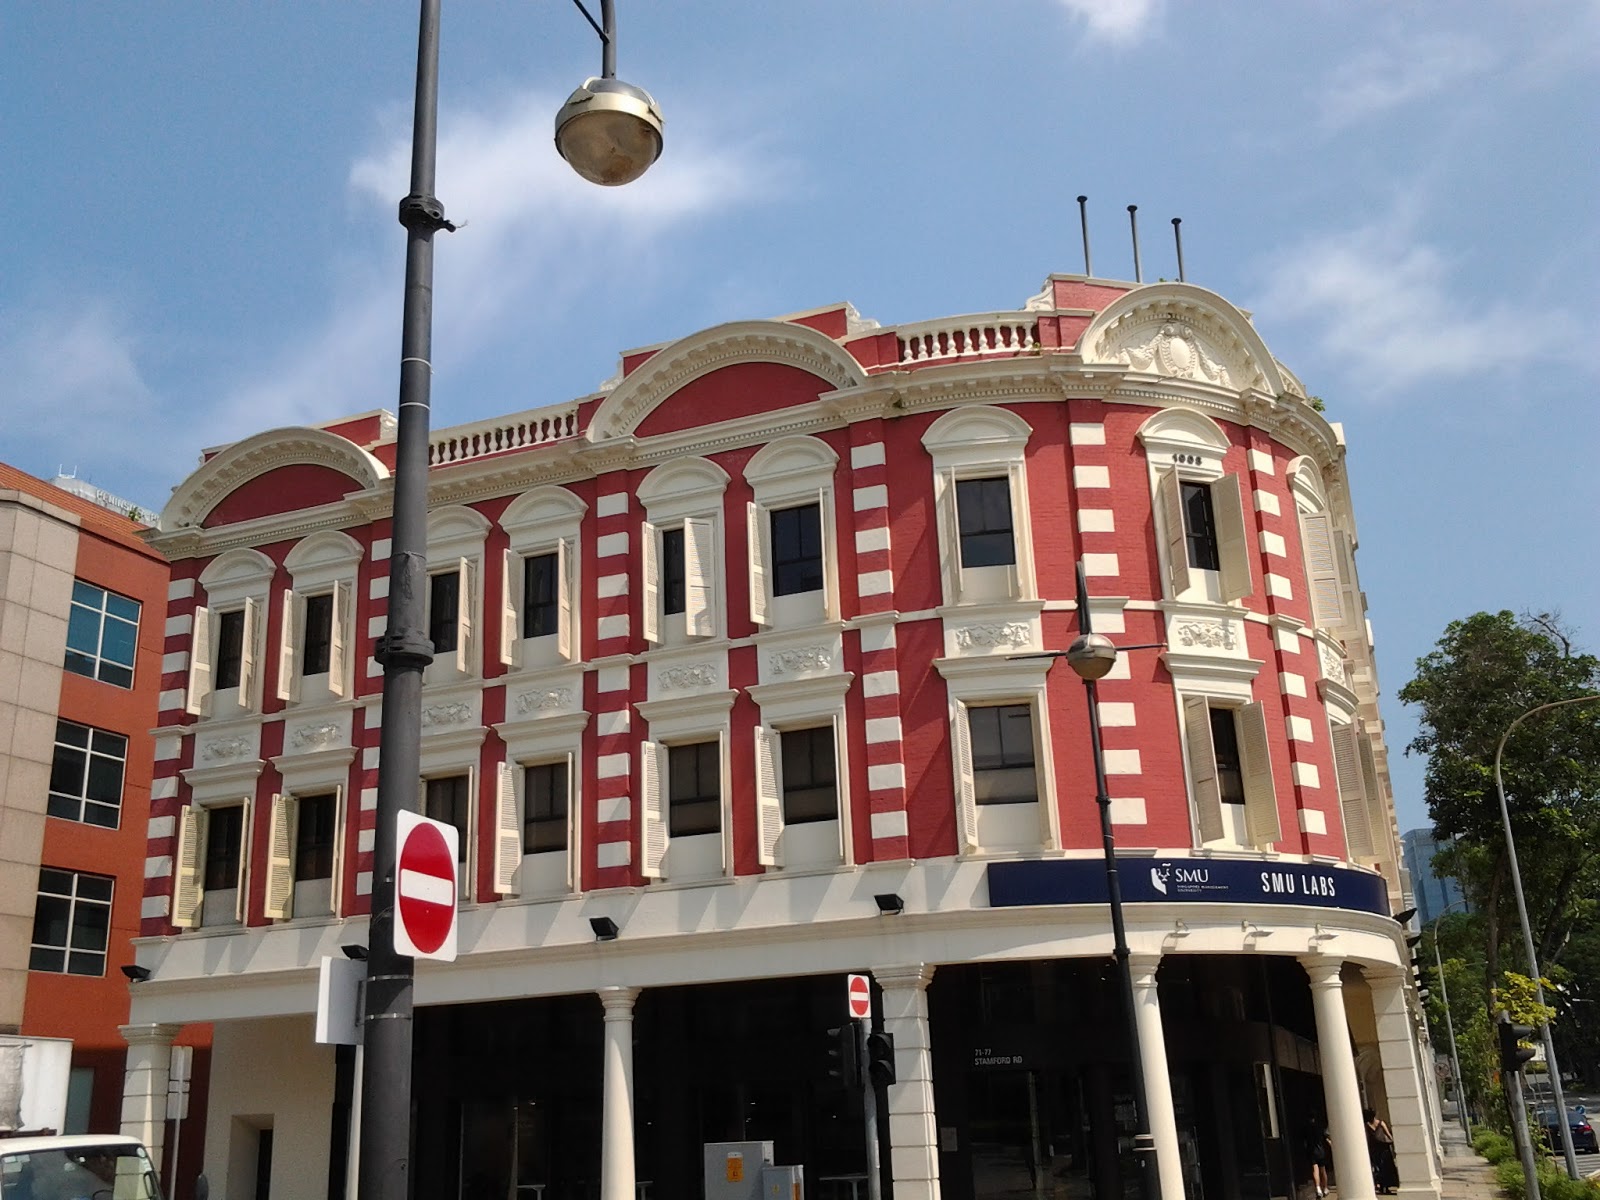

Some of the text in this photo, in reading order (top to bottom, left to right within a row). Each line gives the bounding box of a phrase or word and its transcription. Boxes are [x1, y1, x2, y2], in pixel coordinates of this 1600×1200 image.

[1175, 868, 1209, 883] SMU
[1261, 872, 1336, 897] SMU LABS
[974, 1055, 1023, 1065] STAMFORD RD
